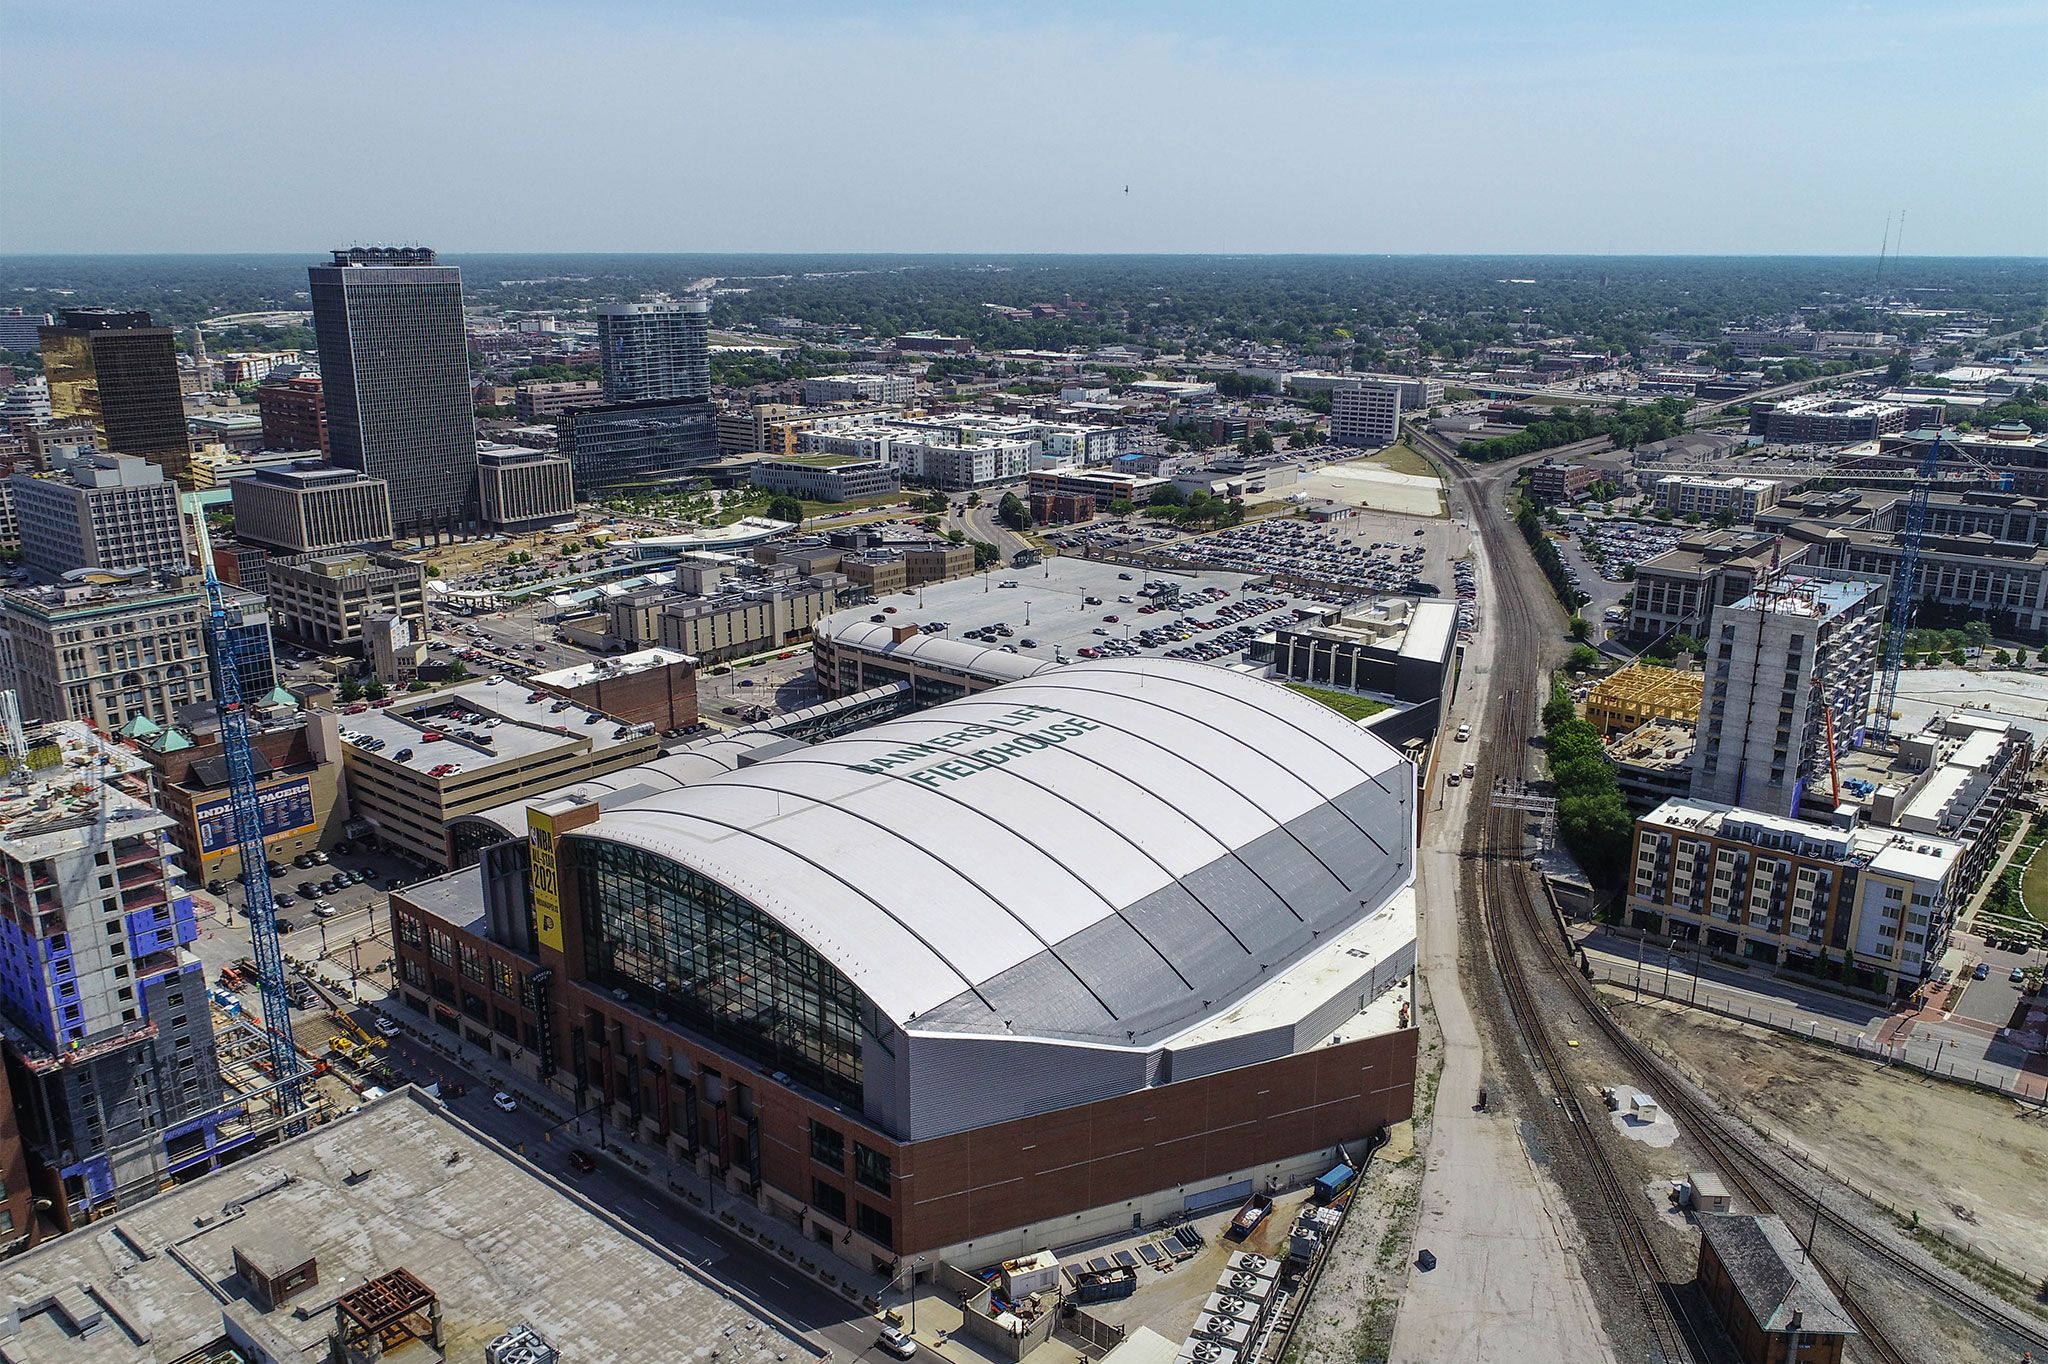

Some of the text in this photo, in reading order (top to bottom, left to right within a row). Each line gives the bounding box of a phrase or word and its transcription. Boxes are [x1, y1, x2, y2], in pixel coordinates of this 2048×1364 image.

[846, 705, 1061, 775] BANKERS LIFE
[908, 718, 1101, 787] FIELDHOUSE
[258, 783, 310, 804] PACERS
[536, 828, 554, 853] NBA
[532, 848, 555, 869] ALL-STAR
[533, 863, 558, 896] 2021
